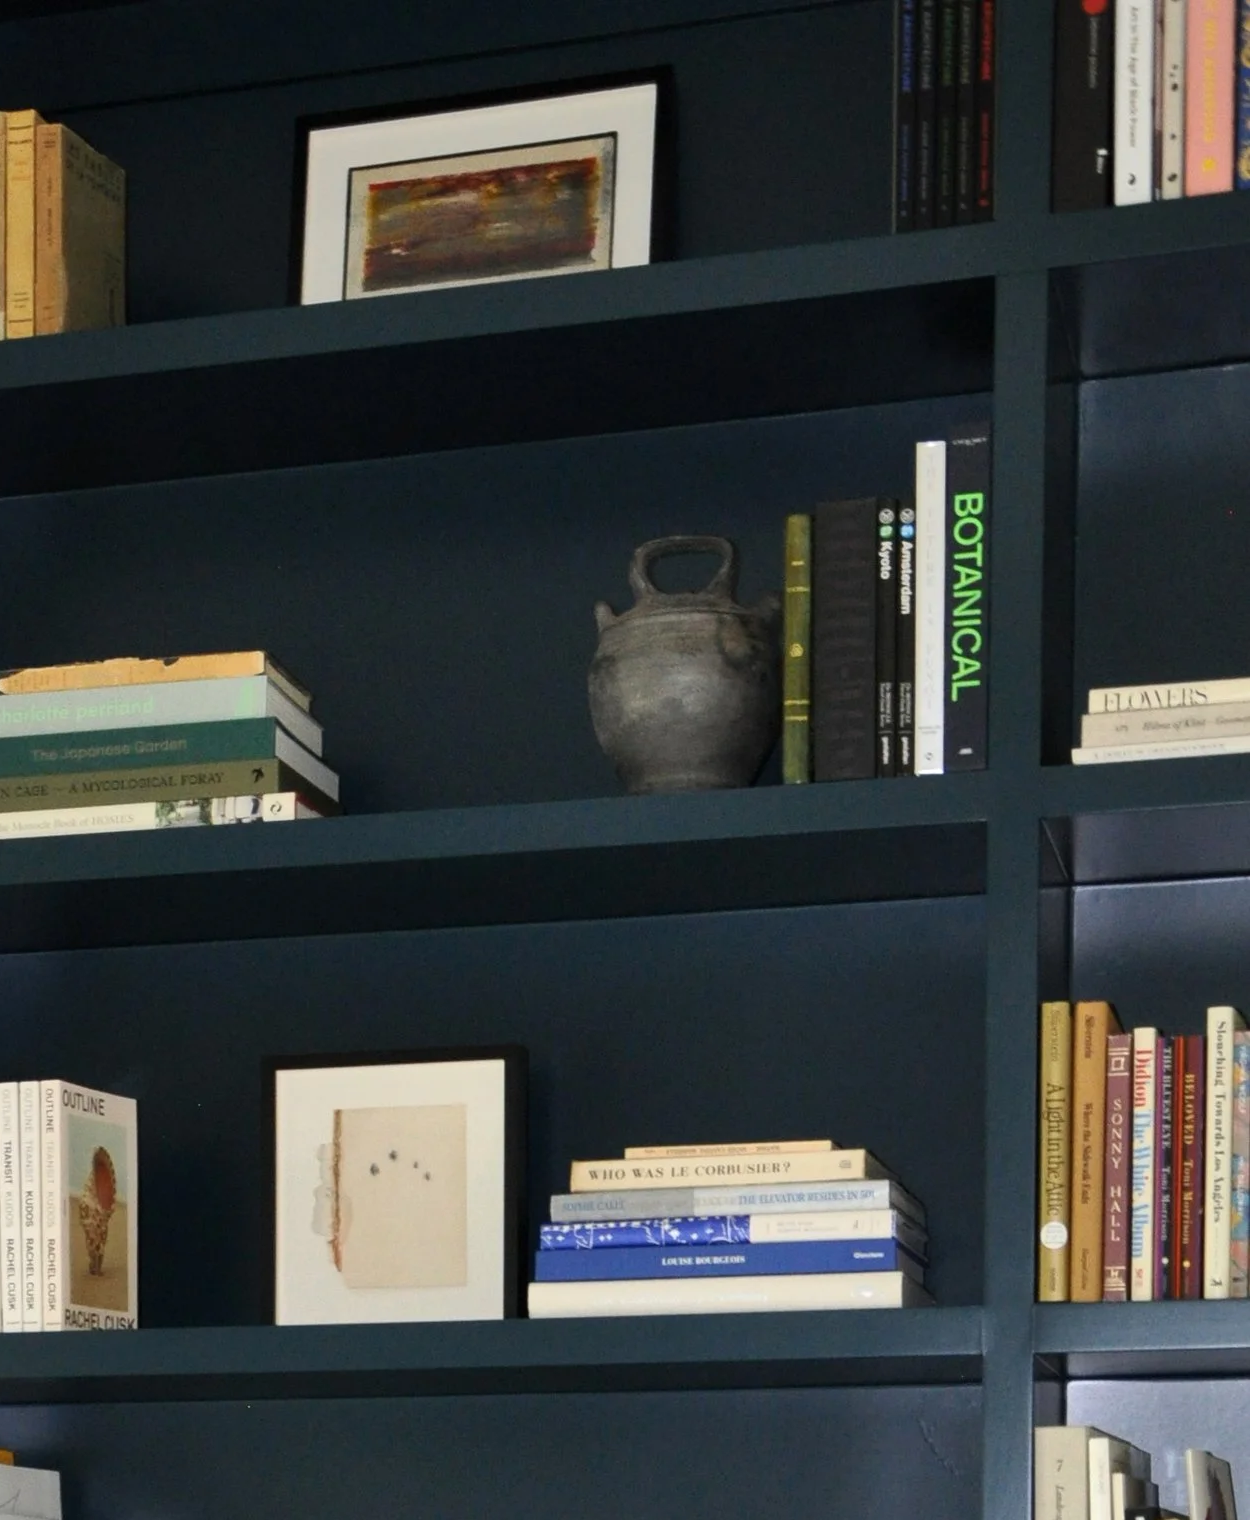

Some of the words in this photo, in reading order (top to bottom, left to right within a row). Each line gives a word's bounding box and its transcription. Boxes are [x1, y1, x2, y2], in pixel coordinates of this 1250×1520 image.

[879, 541, 893, 580] Kyoto
[900, 541, 913, 614] Amsterdam
[951, 492, 985, 702] BOTANICAL
[1103, 686, 1208, 712] FLOWERS
[32, 748, 59, 762] The
[61, 744, 130, 761] Japanese
[134, 738, 188, 753] Garden
[15, 784, 49, 799] CAGE
[81, 773, 178, 793] MYCOLOGICAL
[180, 771, 225, 787] FORAY
[1162, 1047, 1171, 1073] THE
[1215, 1020, 1227, 1087] Slouching
[1046, 1083, 1065, 1096] A
[1134, 1049, 1152, 1108] Didion
[45, 1087, 55, 1134] OUTLINE
[62, 1089, 106, 1117] OUTLINE
[1041, 1098, 1065, 1133] Light
[1162, 1075, 1171, 1121] BLUEST
[1184, 1073, 1195, 1145] BELOVED
[1109, 1099, 1123, 1169] SONNY
[1134, 1110, 1152, 1143] The
[1162, 1124, 1171, 1149] EYE
[1214, 1091, 1226, 1147] Towards
[3, 1141, 12, 1184] TRANSIT
[588, 1168, 626, 1181] WHO
[632, 1166, 665, 1179] WAS
[670, 1165, 690, 1178] LE
[694, 1161, 792, 1177] CORBUSIER?
[1046, 1154, 1064, 1179] the
[1133, 1145, 1152, 1196] White
[1161, 1166, 1170, 1190] Toni
[1183, 1160, 1194, 1187] Toni
[1214, 1151, 1225, 1172] Los
[25, 1190, 34, 1227] KUDOS
[738, 1192, 756, 1206] THE
[759, 1190, 805, 1205] ELEVATOR
[806, 1189, 845, 1202] RESIDES
[846, 1189, 858, 1201] IN
[1046, 1180, 1065, 1217] Attic
[1109, 1187, 1123, 1242] HALL
[1212, 1177, 1224, 1223] Angeles
[1132, 1202, 1151, 1259] Album
[1161, 1194, 1170, 1241] Morrison
[1182, 1191, 1193, 1244] Morrison
[5, 1239, 15, 1279] RACHEL
[26, 1238, 35, 1279] RACHEL
[47, 1239, 56, 1280] RACHEL
[661, 1255, 693, 1266] LOUISE
[695, 1253, 746, 1265] BOURGEOIS
[7, 1281, 16, 1311] CUSK
[26, 1281, 35, 1311] CUSK
[48, 1281, 57, 1312] CUSK
[64, 1309, 104, 1330] RACHEL
[104, 1314, 136, 1331] CUSK
